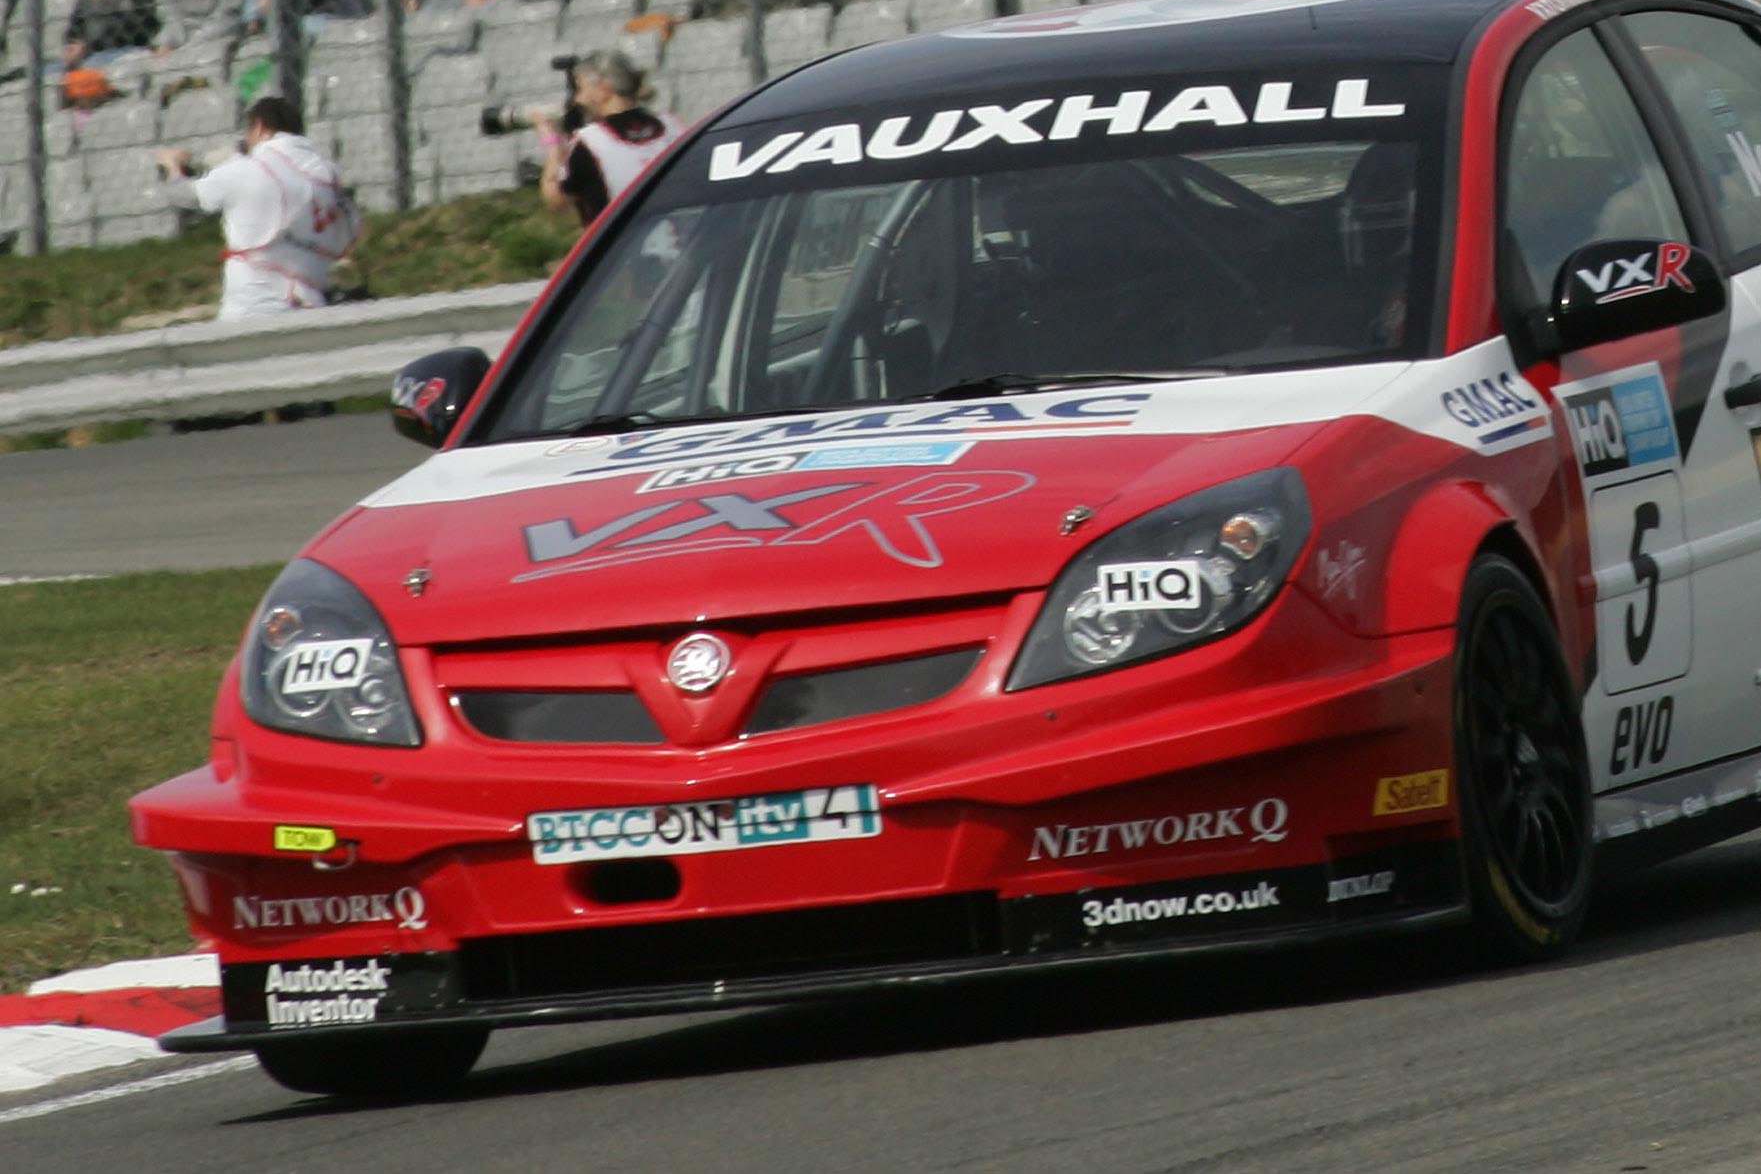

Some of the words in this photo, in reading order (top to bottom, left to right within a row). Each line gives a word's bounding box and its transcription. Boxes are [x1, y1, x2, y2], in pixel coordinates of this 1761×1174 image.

[709, 78, 1406, 181] VAUXHALL
[1576, 241, 1696, 298] VXR
[610, 392, 1154, 462] GMAC
[1440, 371, 1537, 428] GMAC
[1568, 399, 1628, 464] HiQ
[657, 455, 798, 488] HiQ
[524, 469, 1038, 568] VXR
[1106, 567, 1192, 603] HiQ
[1625, 501, 1660, 666] 5
[288, 647, 359, 683] HiQ
[1610, 695, 1675, 776] evo
[282, 829, 330, 849] TOW
[534, 809, 651, 854] BTCC
[655, 803, 722, 844] ON
[1028, 807, 1245, 862] NETWORK
[1250, 798, 1289, 843] Q
[1082, 881, 1280, 927] 3dnow.co.uk
[264, 958, 390, 993] Autodesk
[266, 993, 379, 1024] Inventor
